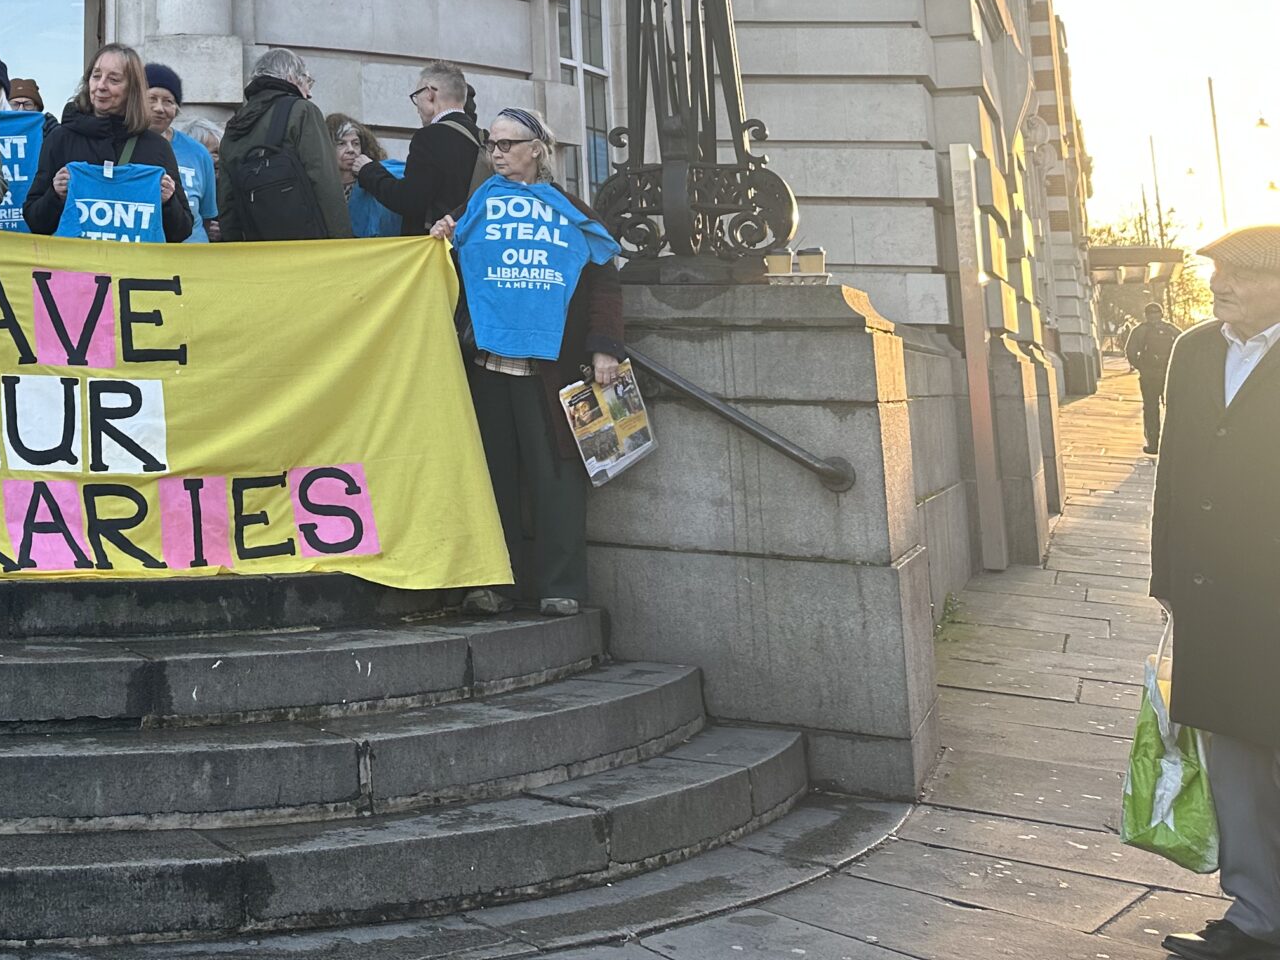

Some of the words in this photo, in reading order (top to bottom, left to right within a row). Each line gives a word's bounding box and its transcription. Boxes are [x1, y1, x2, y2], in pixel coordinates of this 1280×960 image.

[484, 222, 569, 248] STEAL
[501, 248, 549, 266] OUR
[487, 266, 564, 282] LIBRARIES
[497, 281, 551, 291] LAMBETH
